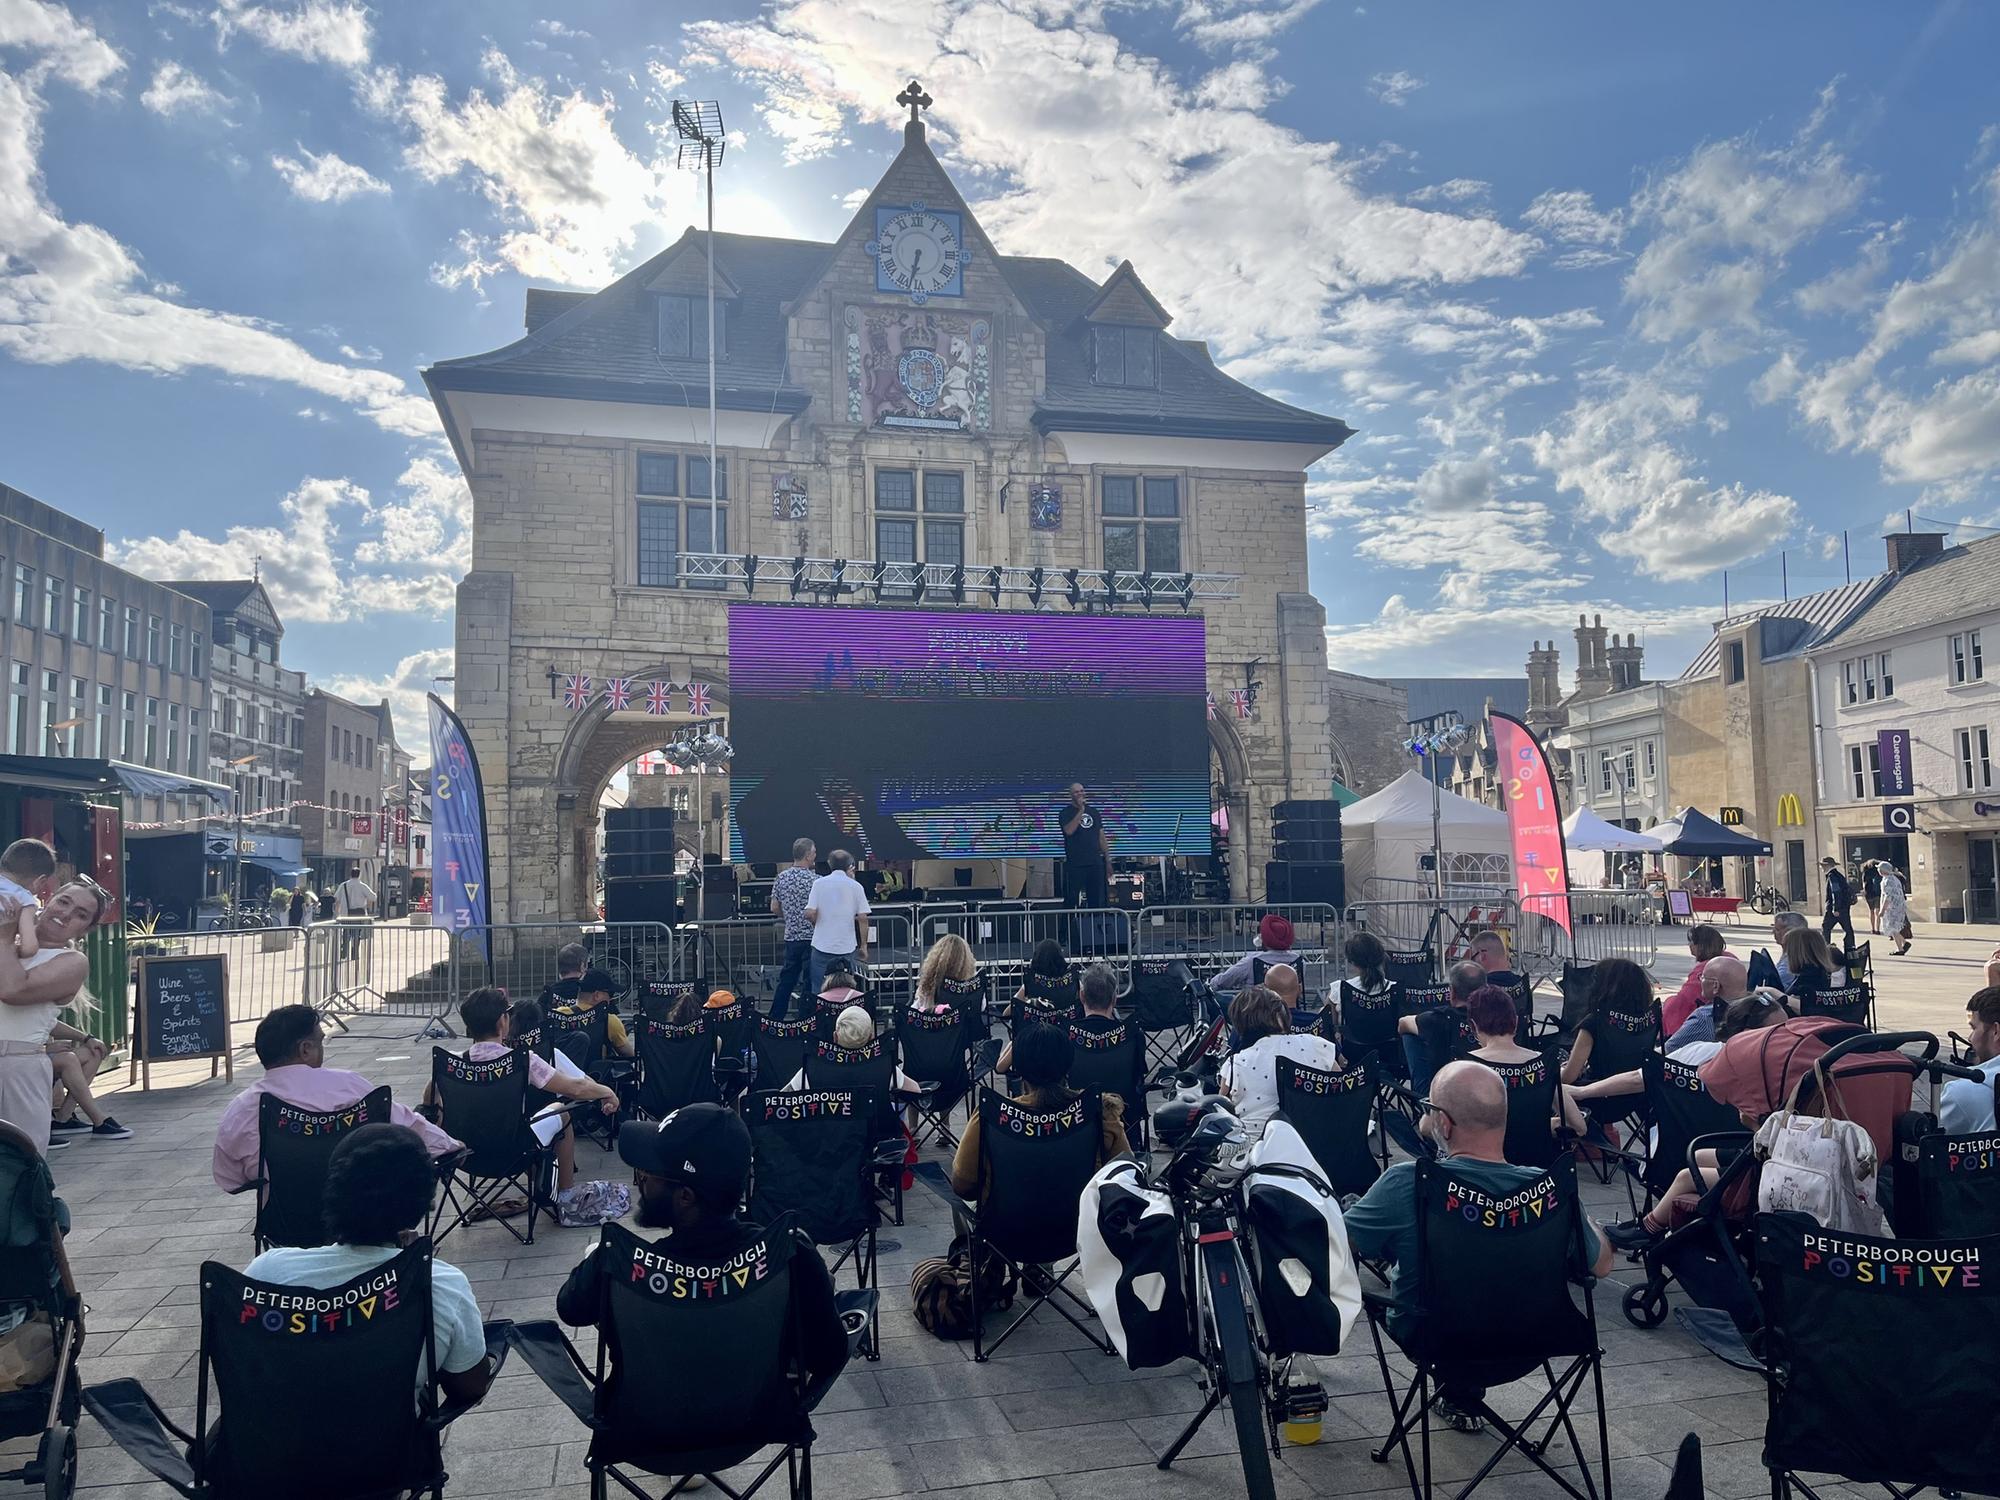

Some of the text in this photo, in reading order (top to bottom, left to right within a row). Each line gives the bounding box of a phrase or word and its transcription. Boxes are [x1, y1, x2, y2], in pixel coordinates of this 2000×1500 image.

[910, 217, 924, 227] XII
[928, 640, 1028, 654] POSITIVE
[1892, 734, 1903, 790] Queensgate
[1890, 807, 1911, 829] Q
[159, 977, 184, 989] Wine,
[160, 990, 191, 1003] Beers
[162, 1015, 201, 1032] Spirits
[648, 1025, 704, 1039] POSITIVE
[760, 1022, 817, 1037] POSITIVE
[761, 1016, 816, 1030] PETERBOROUGH
[1068, 1031, 1126, 1048] POSITIVE
[1069, 1025, 1126, 1041] PETERBOROUGH
[817, 1045, 881, 1063] POSITIVE
[447, 1063, 514, 1082] POSITIVE
[1294, 1074, 1366, 1095] POSITIVE
[765, 1092, 851, 1106] PETERBOROUGH
[765, 1102, 851, 1120] POSITIVE
[278, 1110, 369, 1136] POSITIVE
[1000, 1108, 1084, 1136] POSITIVE
[1447, 1177, 1556, 1212] PETERBOROUGH
[1446, 1192, 1558, 1229] POSITIVE
[1803, 1234, 1980, 1263] PETERBOROUGH
[634, 1241, 767, 1280] PETERBOROUGH
[1803, 1250, 1981, 1287] POSITIVE
[631, 1255, 768, 1299] POSITIVE
[242, 1269, 397, 1313] PETERBOROUGH
[240, 1285, 400, 1334] POSITIVE
